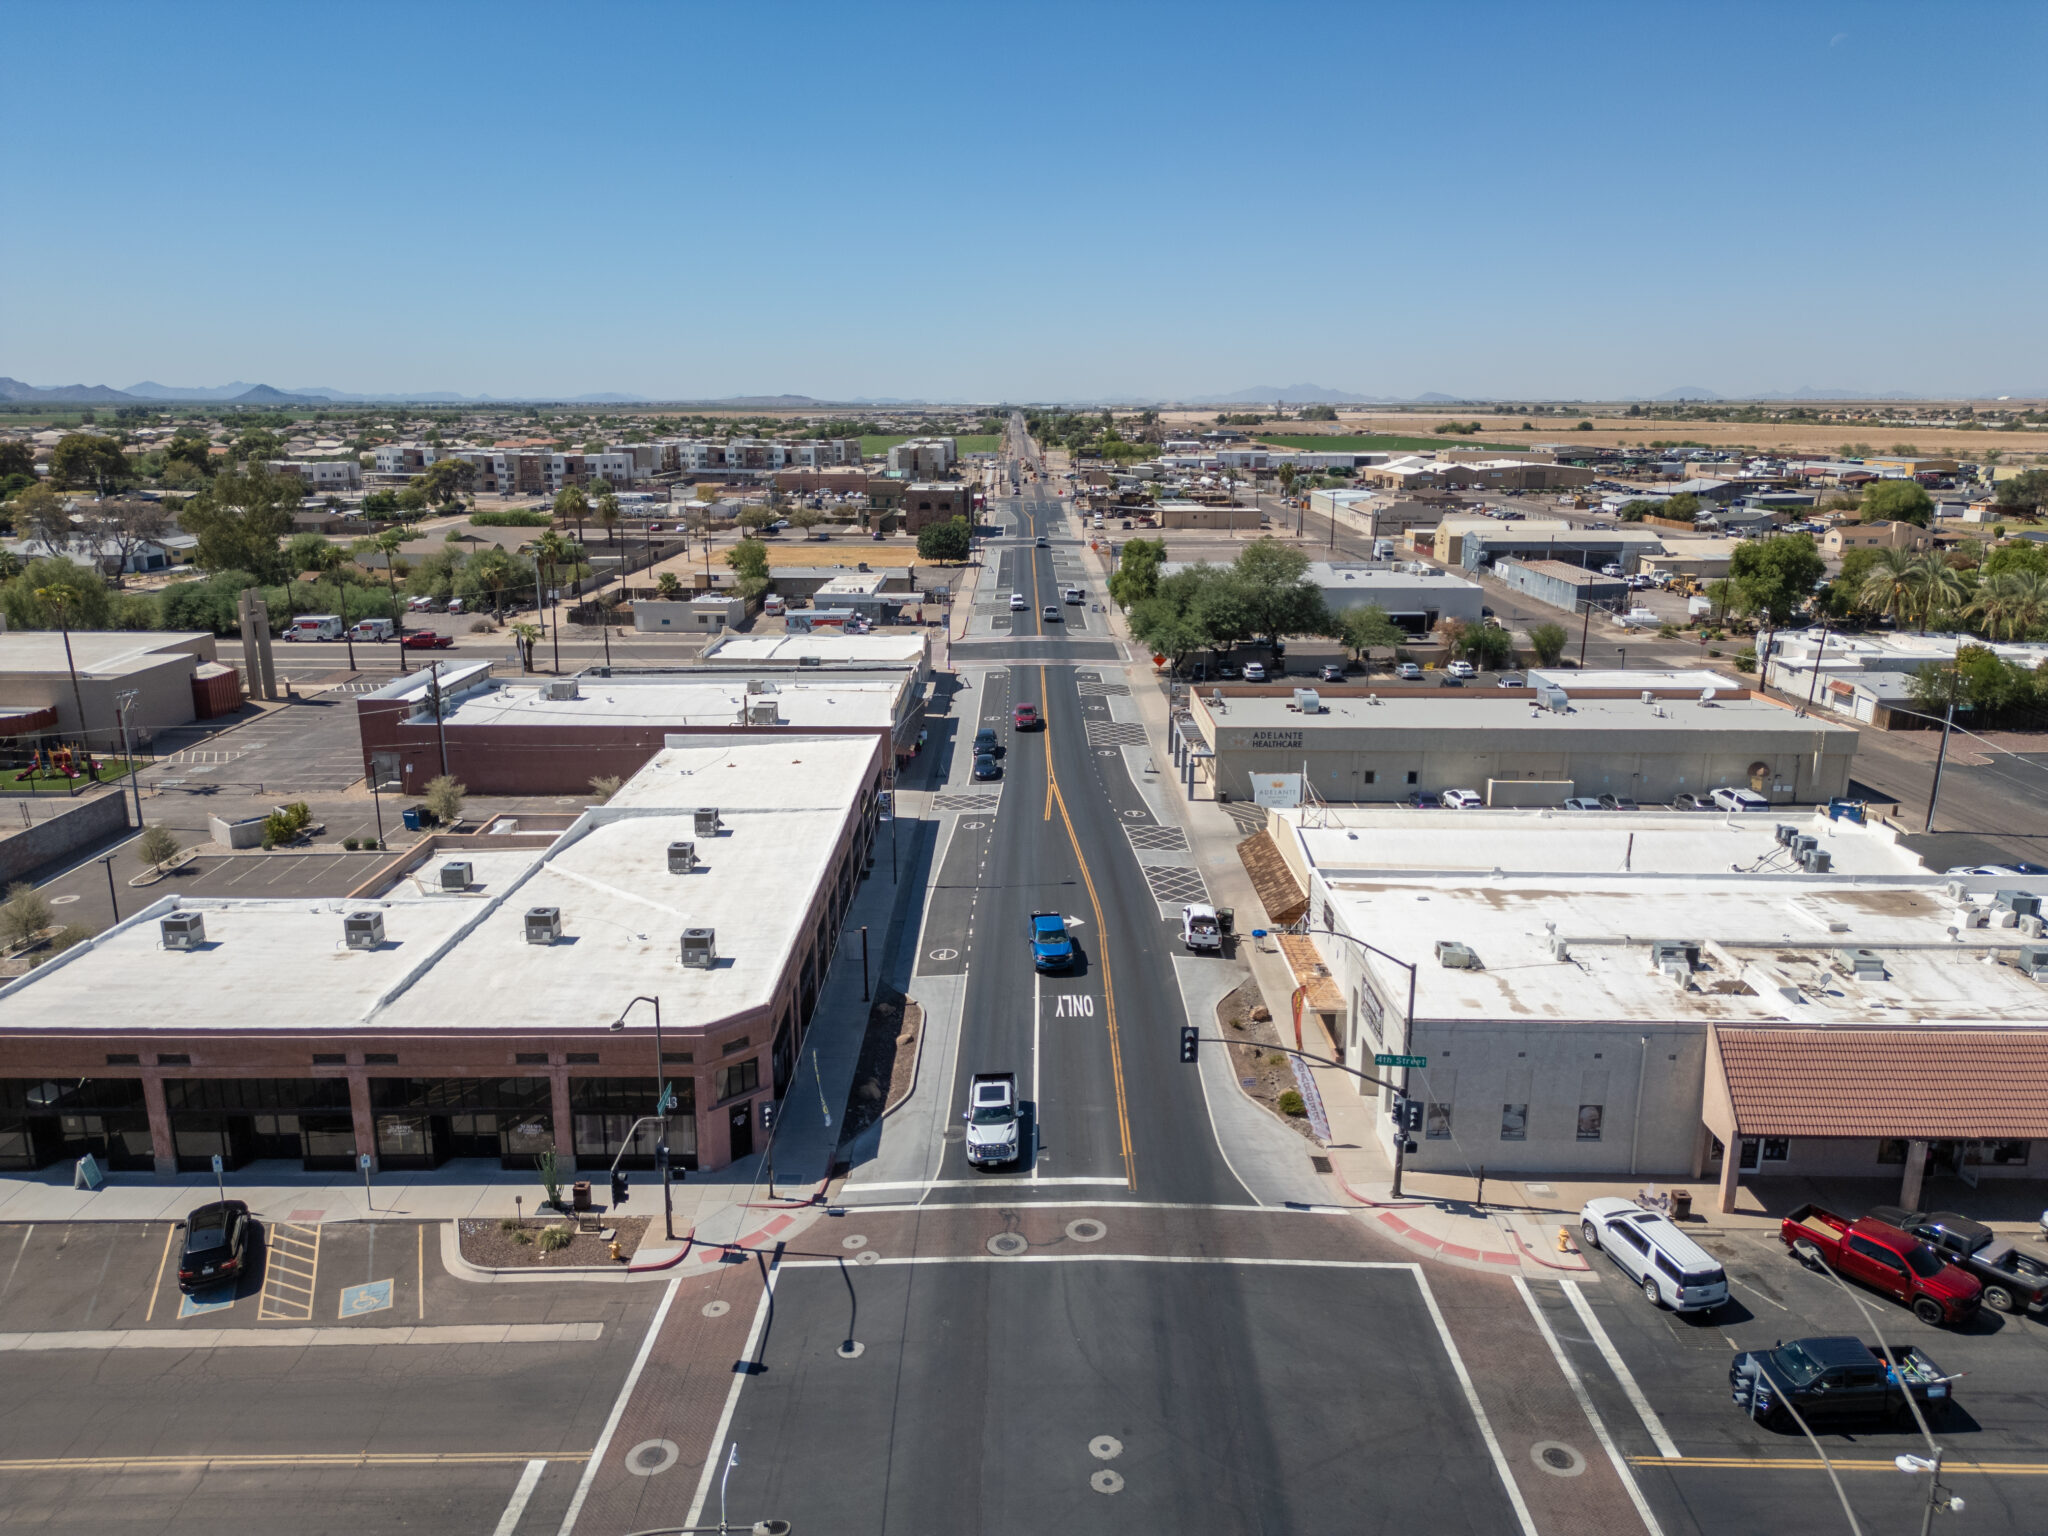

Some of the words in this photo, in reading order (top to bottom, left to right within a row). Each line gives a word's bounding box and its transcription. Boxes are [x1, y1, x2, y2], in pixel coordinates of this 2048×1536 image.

[1253, 732, 1303, 740] ADELANTE
[1253, 740, 1303, 748] HEALTHCARE
[1056, 995, 1094, 1017] ONLY
[1376, 1056, 1392, 1064] 4th
[1395, 1057, 1425, 1066] Street
